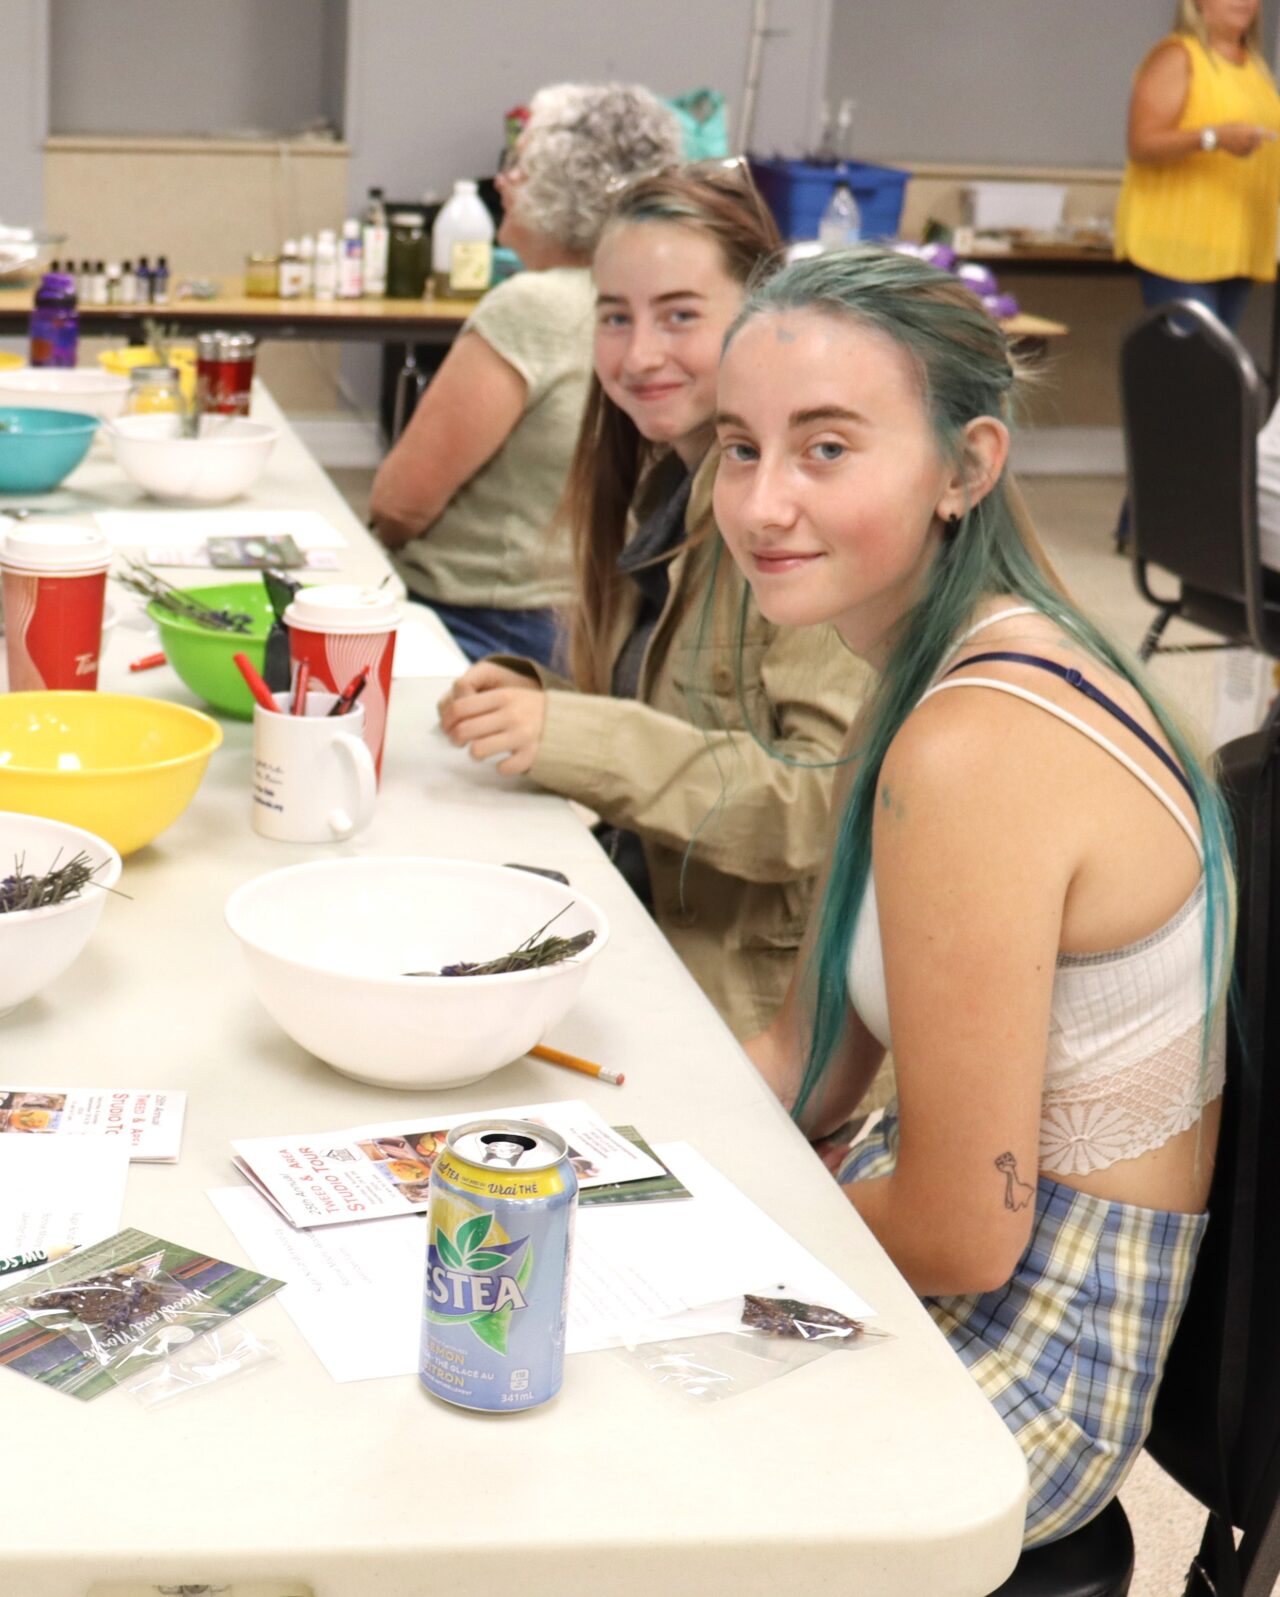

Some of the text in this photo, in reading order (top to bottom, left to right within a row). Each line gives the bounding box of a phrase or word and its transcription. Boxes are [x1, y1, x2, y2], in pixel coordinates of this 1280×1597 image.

[108, 1093, 129, 1121] STUDIO
[278, 1148, 303, 1169] AREA
[298, 1147, 330, 1173] TOUR
[278, 1173, 306, 1198] Annual
[447, 1168, 460, 1181] TEA
[310, 1185, 339, 1213] TWEED
[324, 1175, 365, 1212] STUDIO
[480, 1371, 494, 1381] AU
